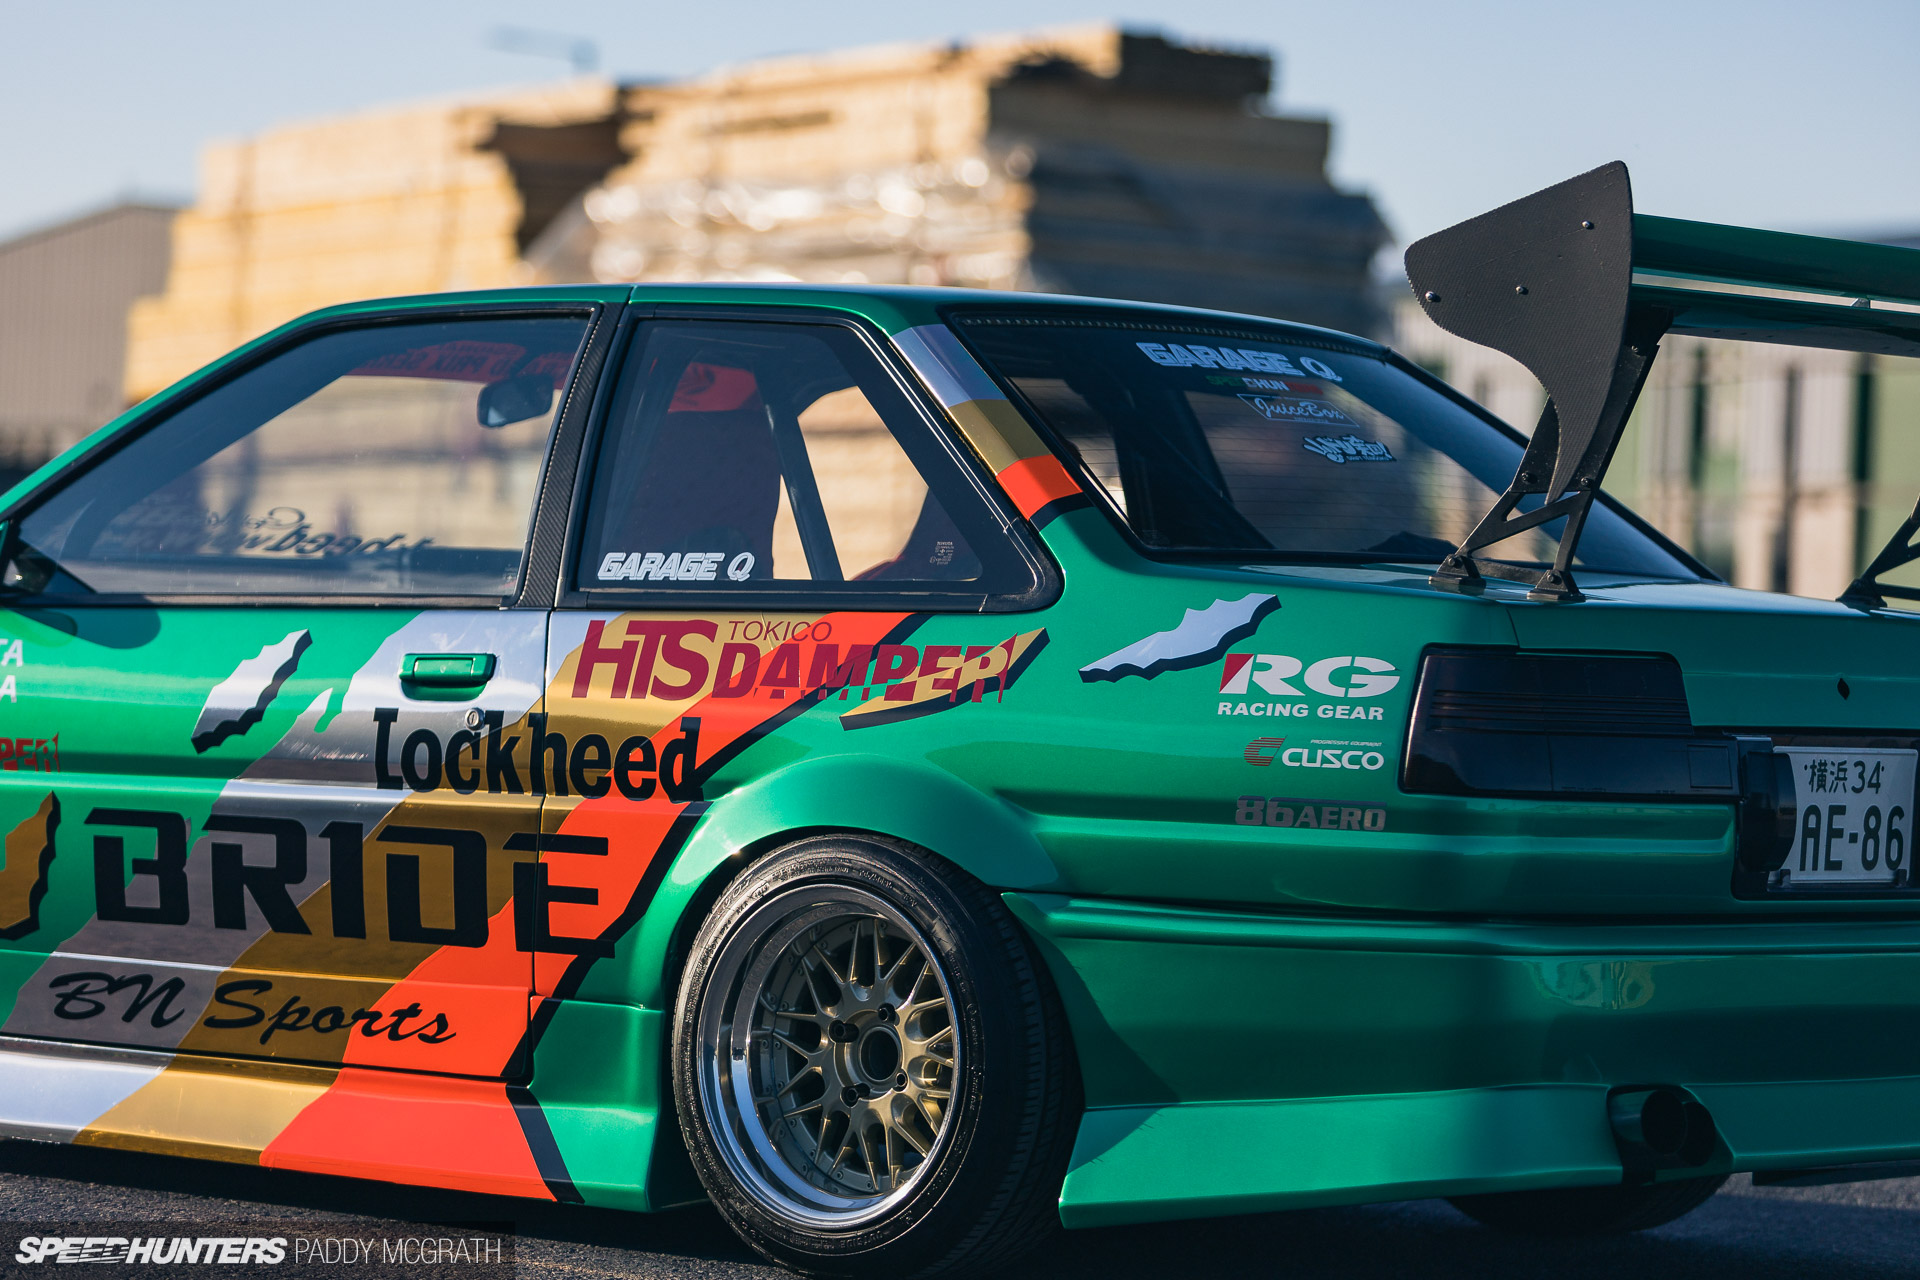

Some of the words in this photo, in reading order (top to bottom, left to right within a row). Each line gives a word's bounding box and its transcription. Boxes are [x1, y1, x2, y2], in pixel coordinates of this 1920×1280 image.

[1136, 342, 1306, 377] GARAGE
[1299, 355, 1343, 383] Q
[1253, 397, 1345, 420] JuiceBox
[597, 552, 725, 581] GARAGE
[727, 551, 755, 582] Q
[729, 620, 832, 642] TOKICO
[571, 619, 719, 701] HTS
[711, 632, 1019, 704] DAMPER
[1219, 653, 1400, 698] RG
[1217, 702, 1309, 718] RACING
[1317, 704, 1384, 720] GEAR
[373, 707, 705, 805] Lockheed
[1282, 747, 1384, 770] CUSCO
[1799, 804, 1905, 871] AE-86
[83, 807, 616, 959] BRIDE
[48, 970, 186, 1029] BN
[203, 979, 457, 1046] Sports
